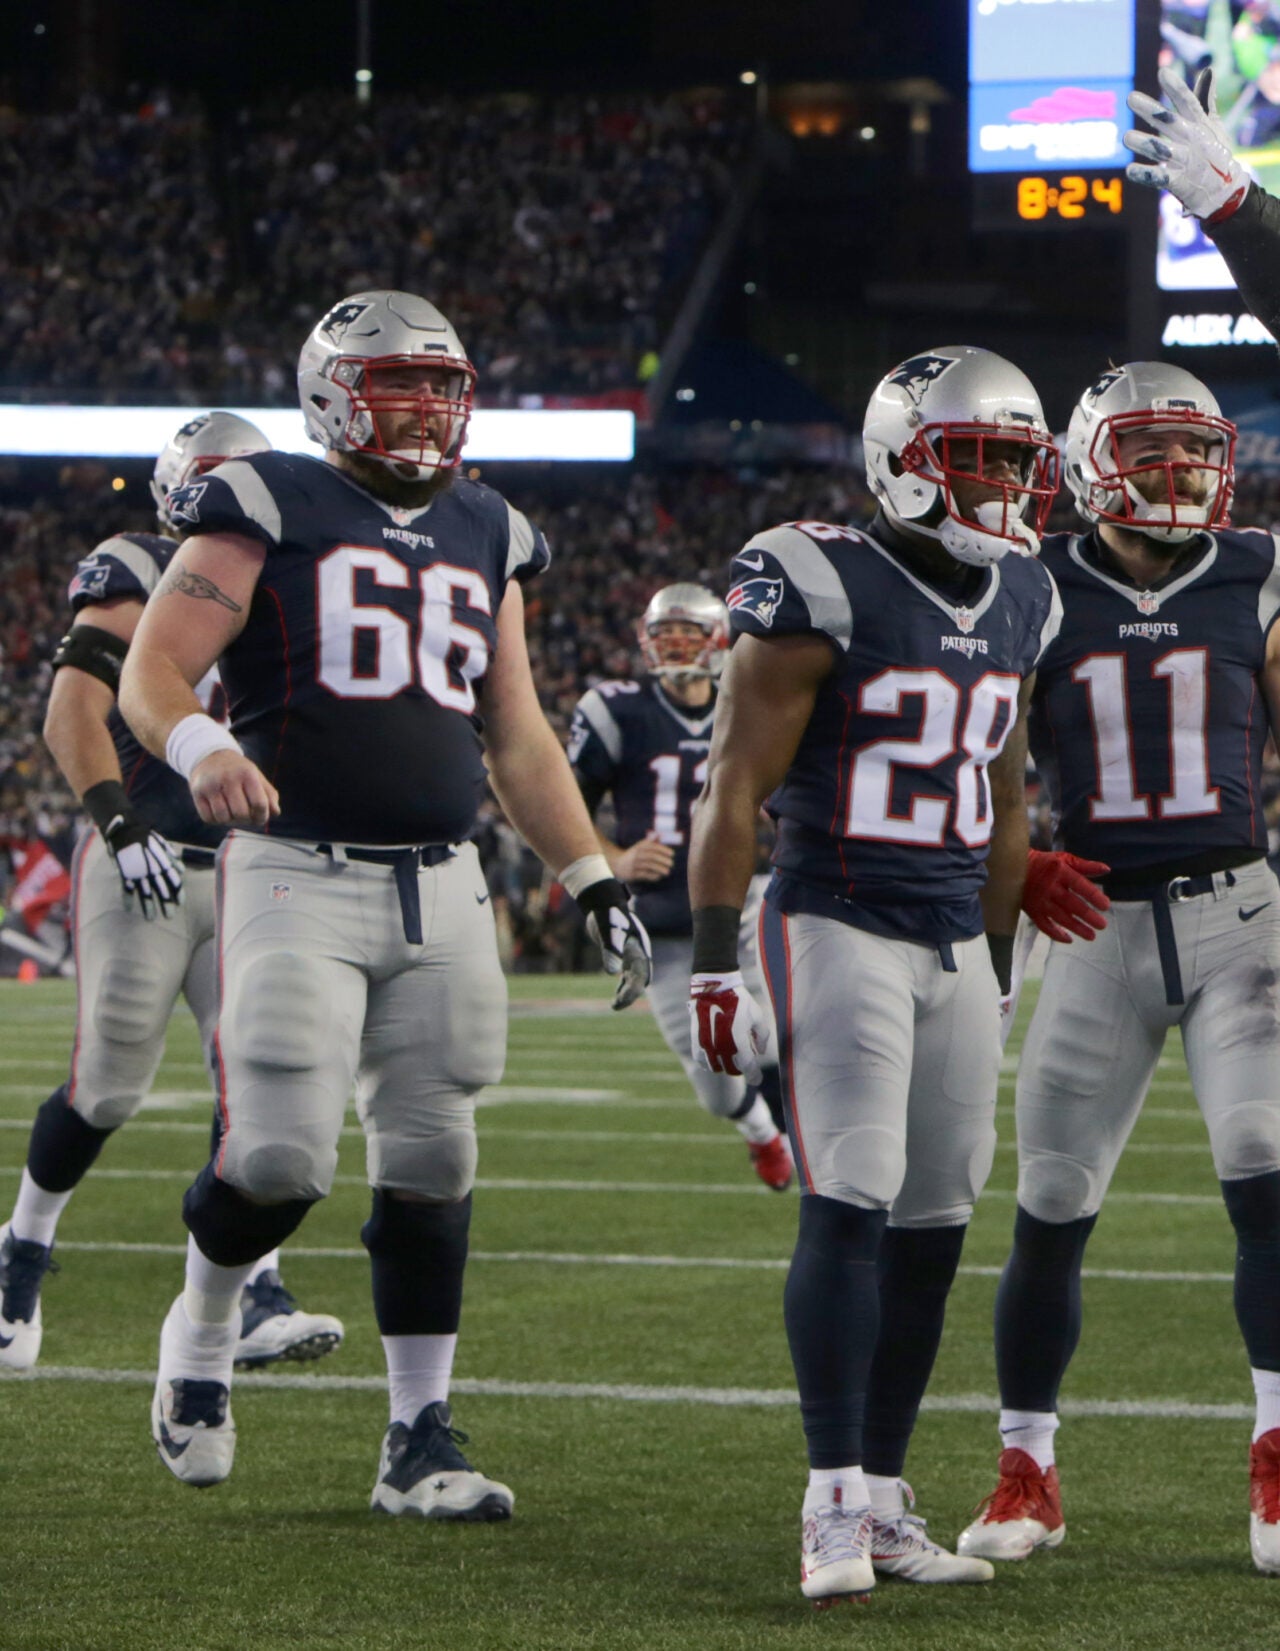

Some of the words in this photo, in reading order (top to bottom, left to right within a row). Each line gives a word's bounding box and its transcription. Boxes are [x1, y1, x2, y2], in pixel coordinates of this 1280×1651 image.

[1018, 176, 1122, 219] 8:24
[1162, 314, 1233, 346] ALEX
[383, 527, 434, 549] PATRIOTS
[315, 544, 494, 716] 66
[941, 636, 988, 655] PATRIOTS
[1119, 622, 1178, 639] PATRIOTS
[1072, 646, 1222, 822] 11
[844, 665, 1022, 847] 28
